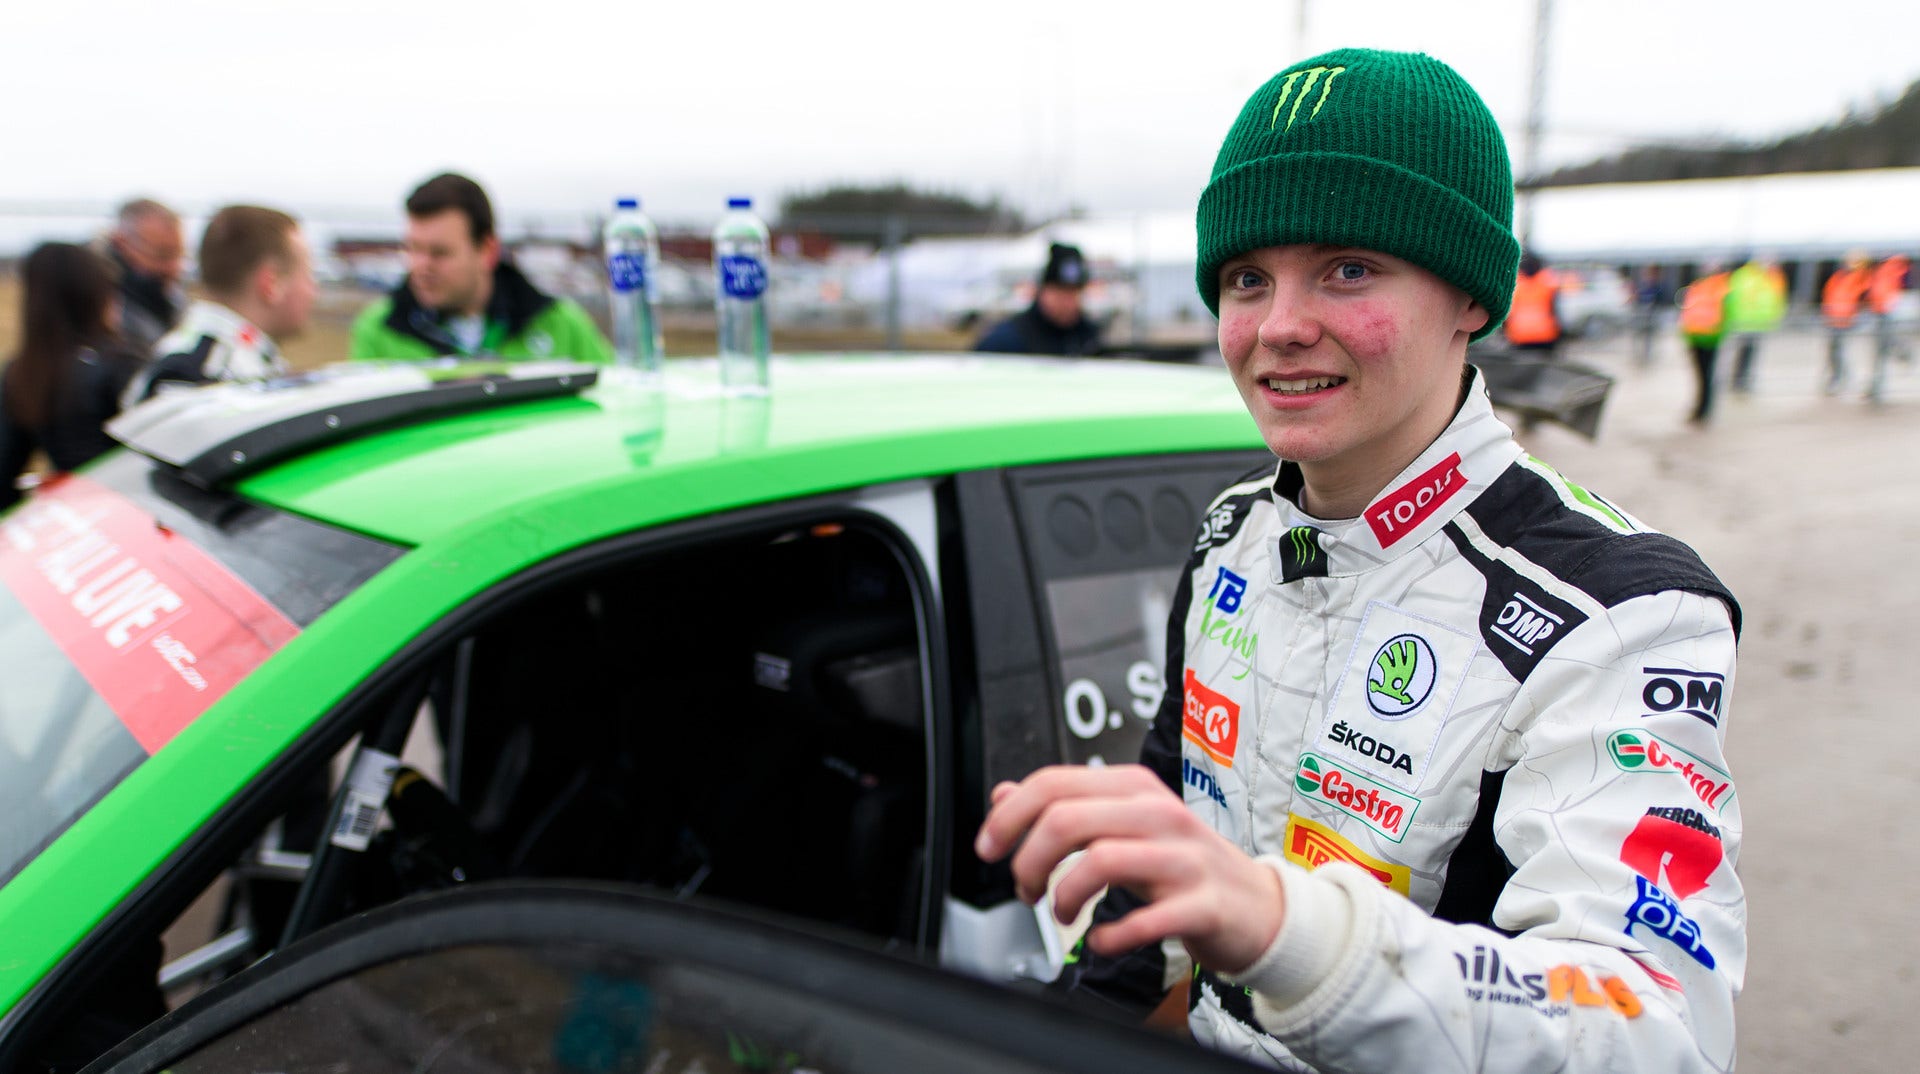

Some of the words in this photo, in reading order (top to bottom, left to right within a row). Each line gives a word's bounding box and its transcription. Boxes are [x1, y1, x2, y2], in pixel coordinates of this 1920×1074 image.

[1376, 468, 1454, 532] TOOLS
[1496, 600, 1555, 646] OMP
[1642, 677, 1723, 718] OM
[1327, 719, 1414, 775] ŠKODA
[1647, 739, 1729, 811] Ctrol
[1321, 770, 1404, 835] Castro
